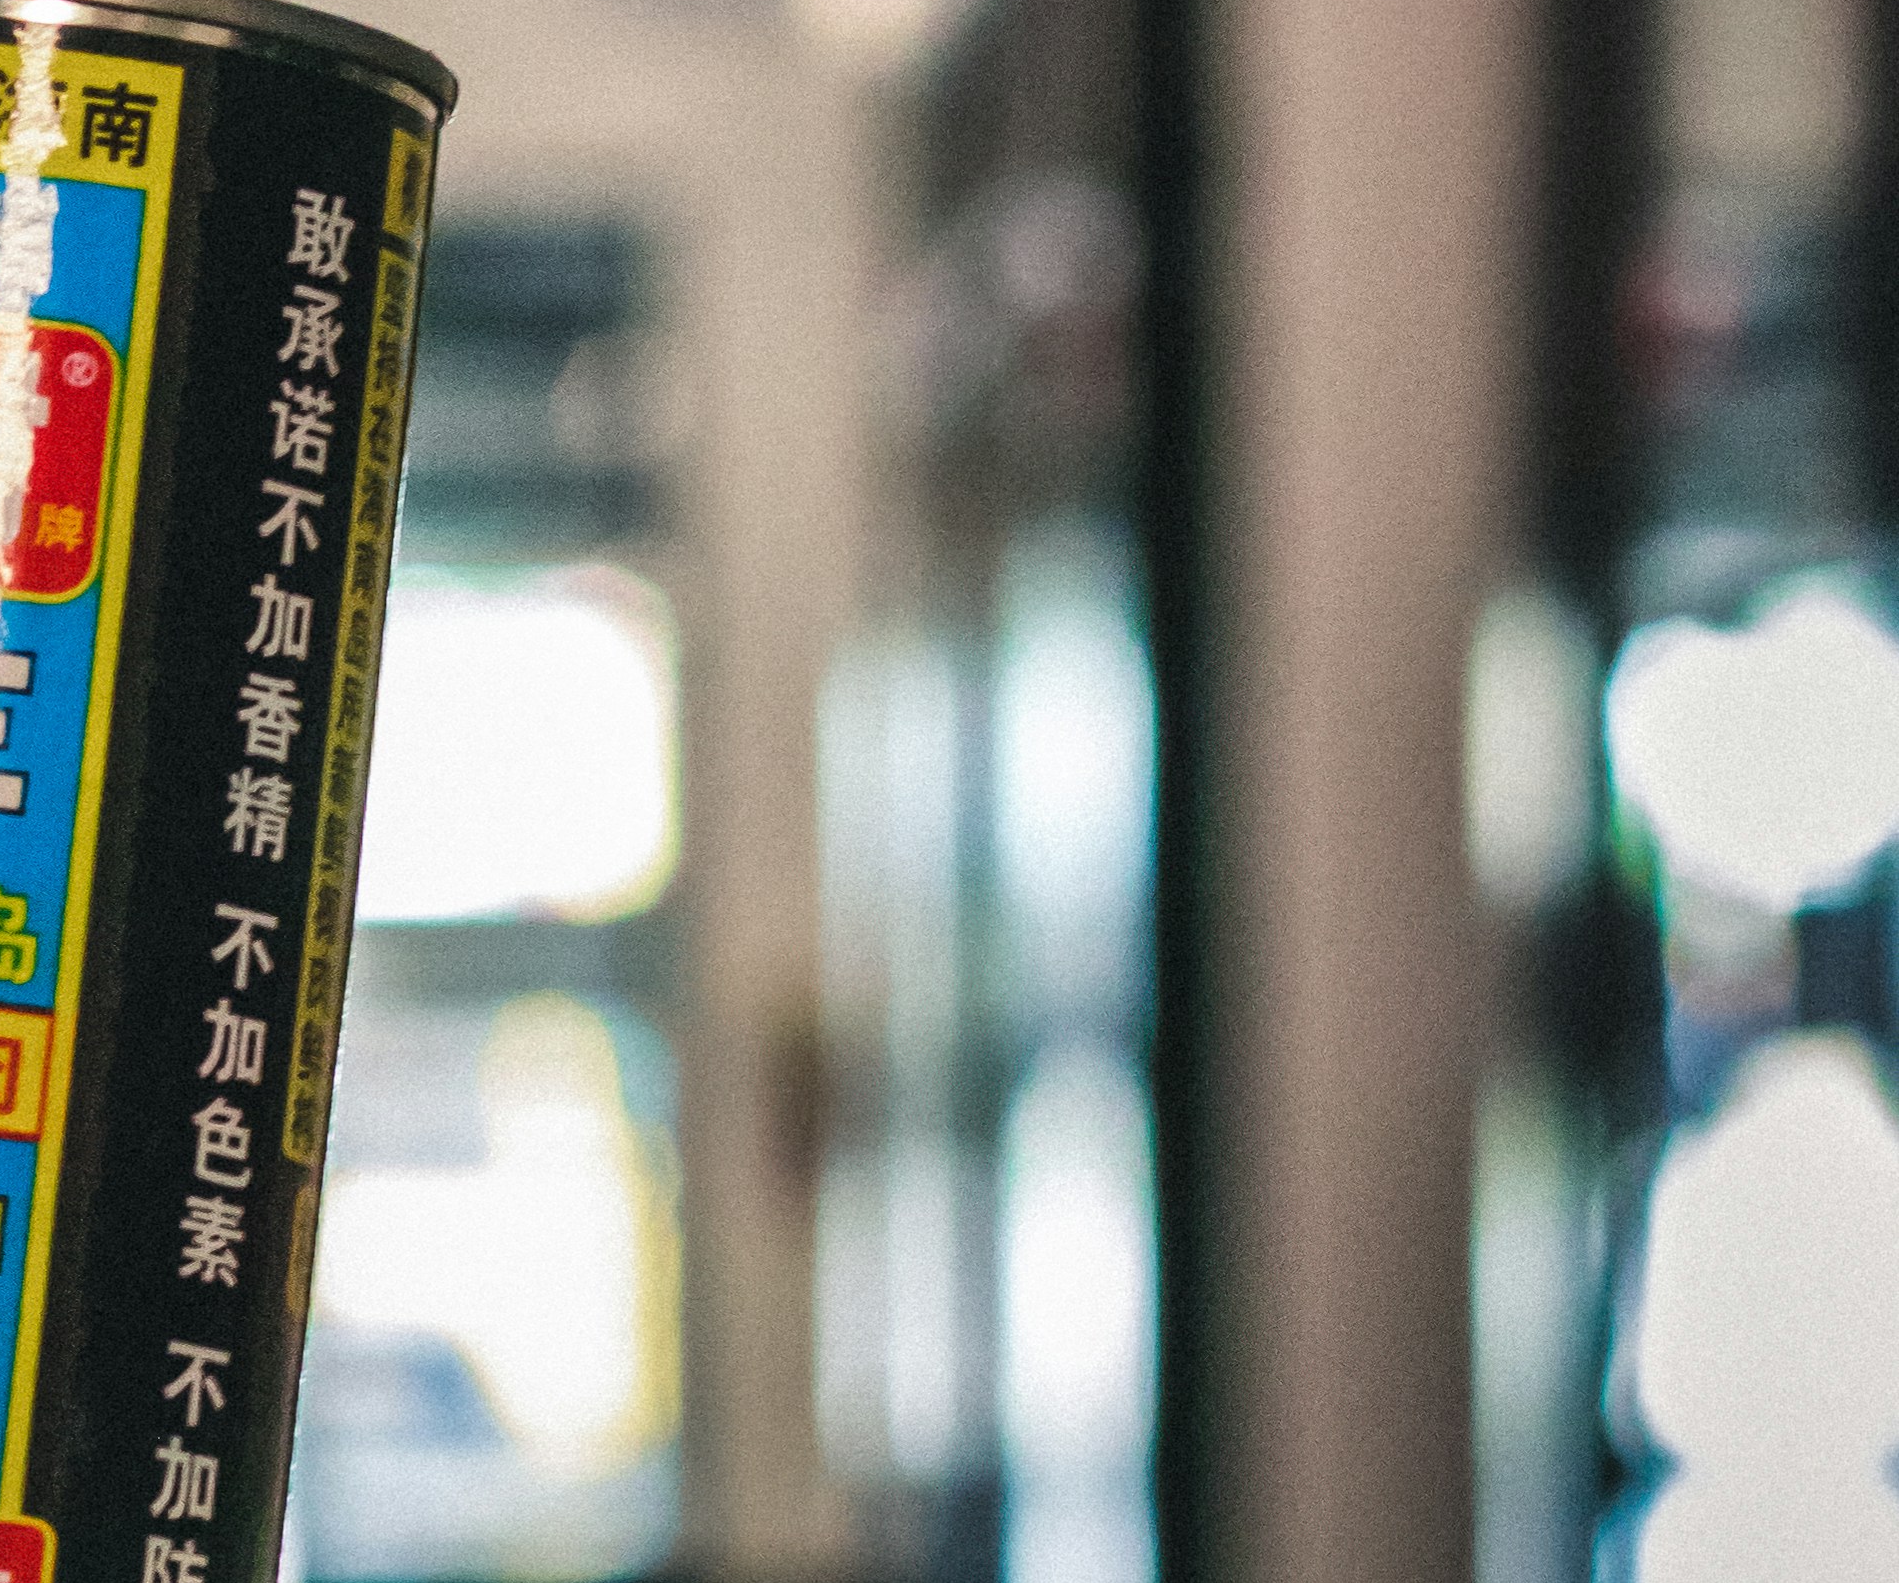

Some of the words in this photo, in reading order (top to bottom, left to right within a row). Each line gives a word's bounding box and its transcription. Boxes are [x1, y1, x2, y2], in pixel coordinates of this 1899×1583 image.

[221, 187, 355, 864] 敢承诺不加香精
[177, 901, 278, 1289] 不加色素
